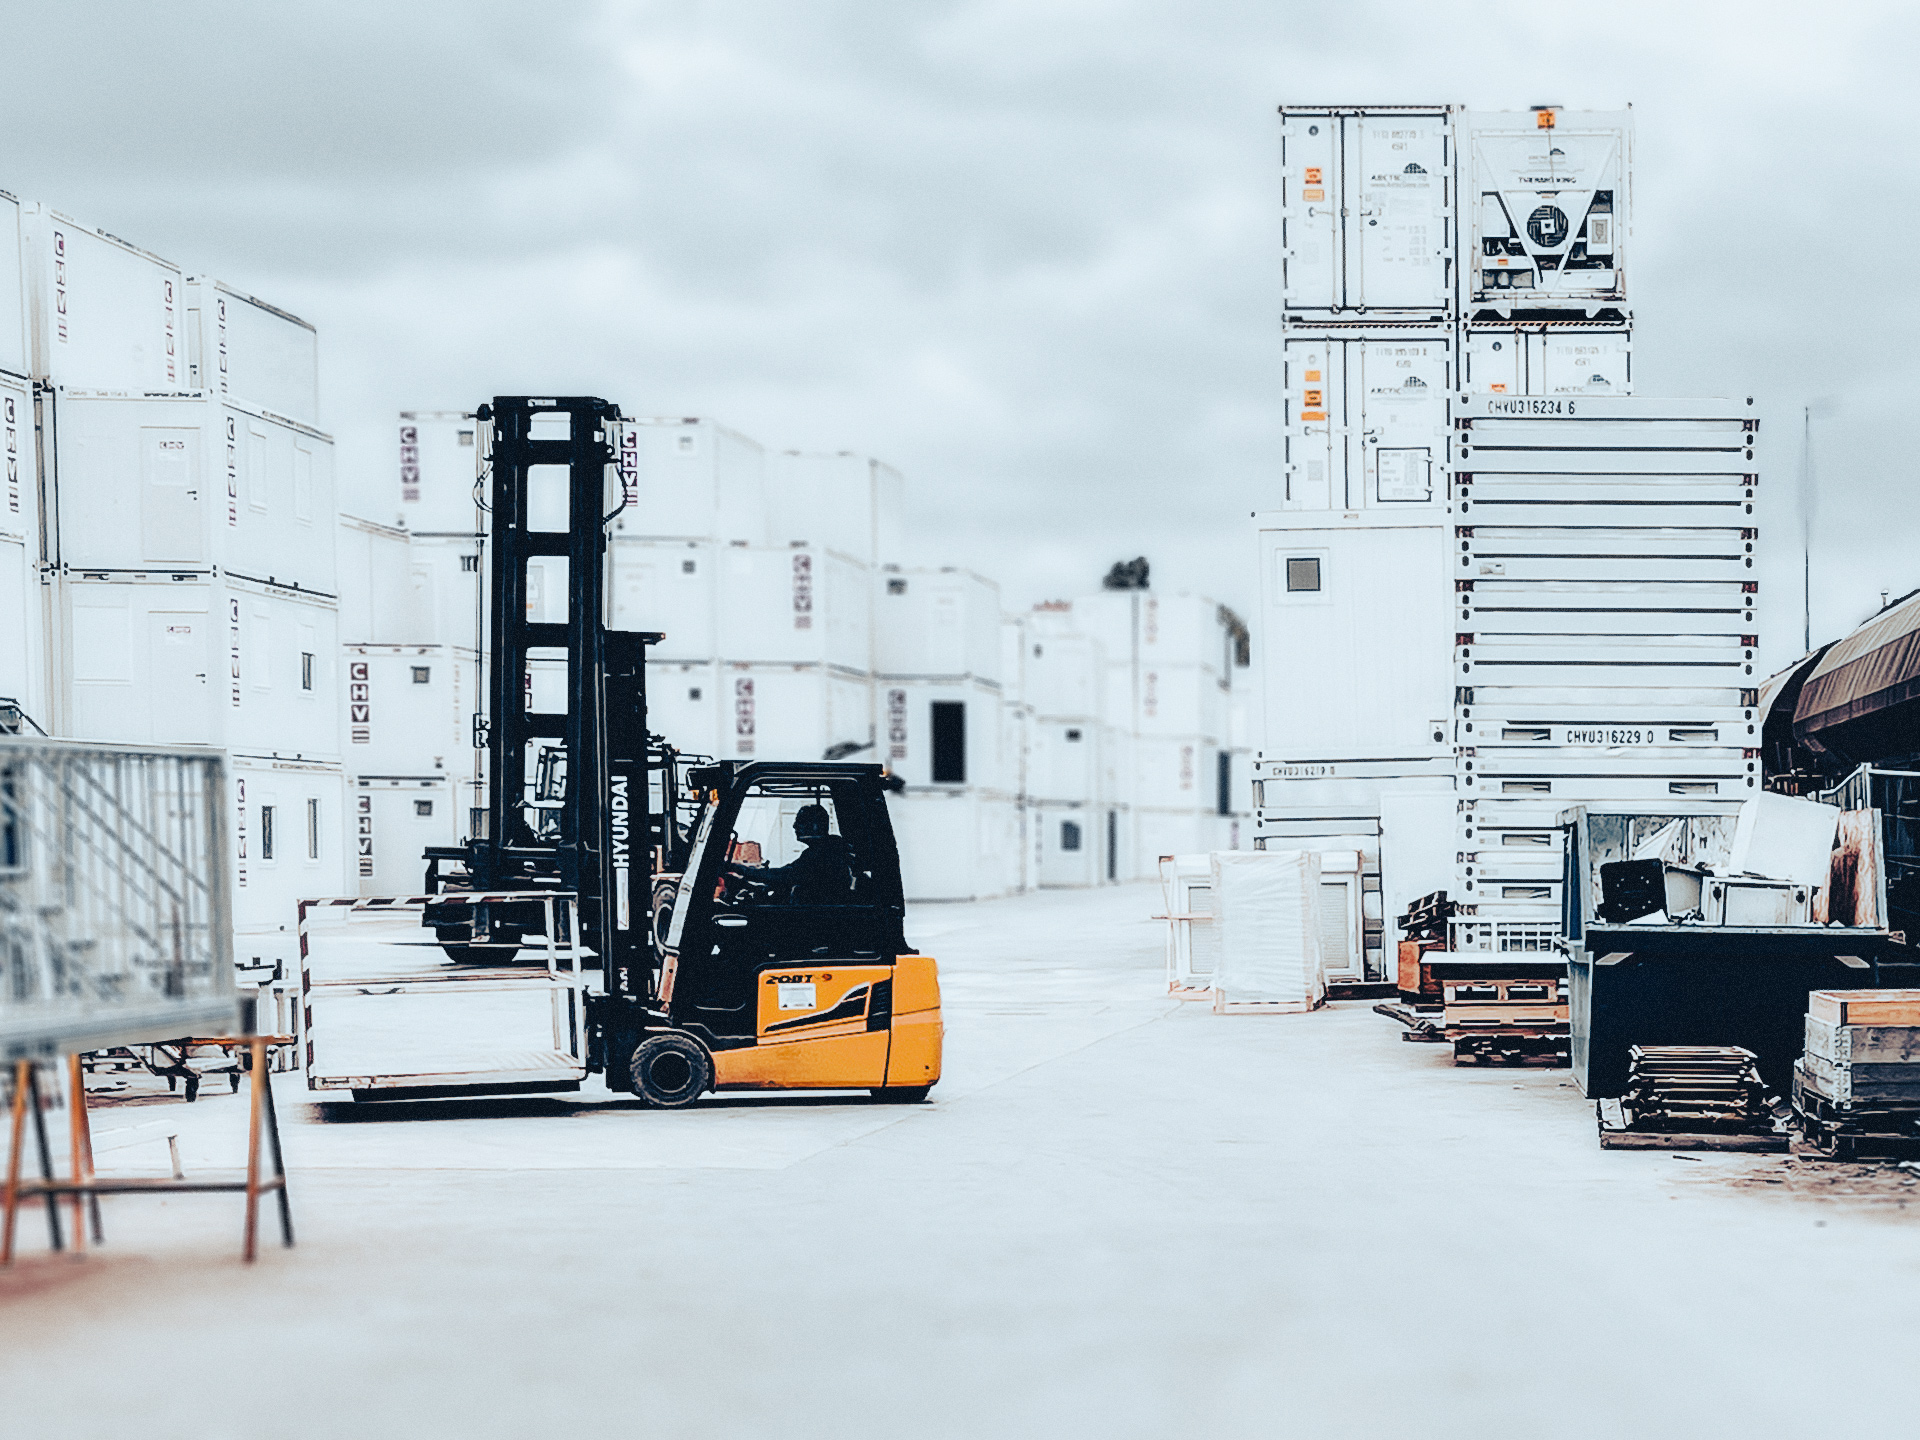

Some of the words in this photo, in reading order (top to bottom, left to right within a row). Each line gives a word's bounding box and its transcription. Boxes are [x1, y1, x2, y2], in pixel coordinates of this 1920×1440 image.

[1568, 400, 1575, 415] 6
[1566, 729, 1641, 744] CHVU316229
[610, 775, 630, 868] HYUNDAI
